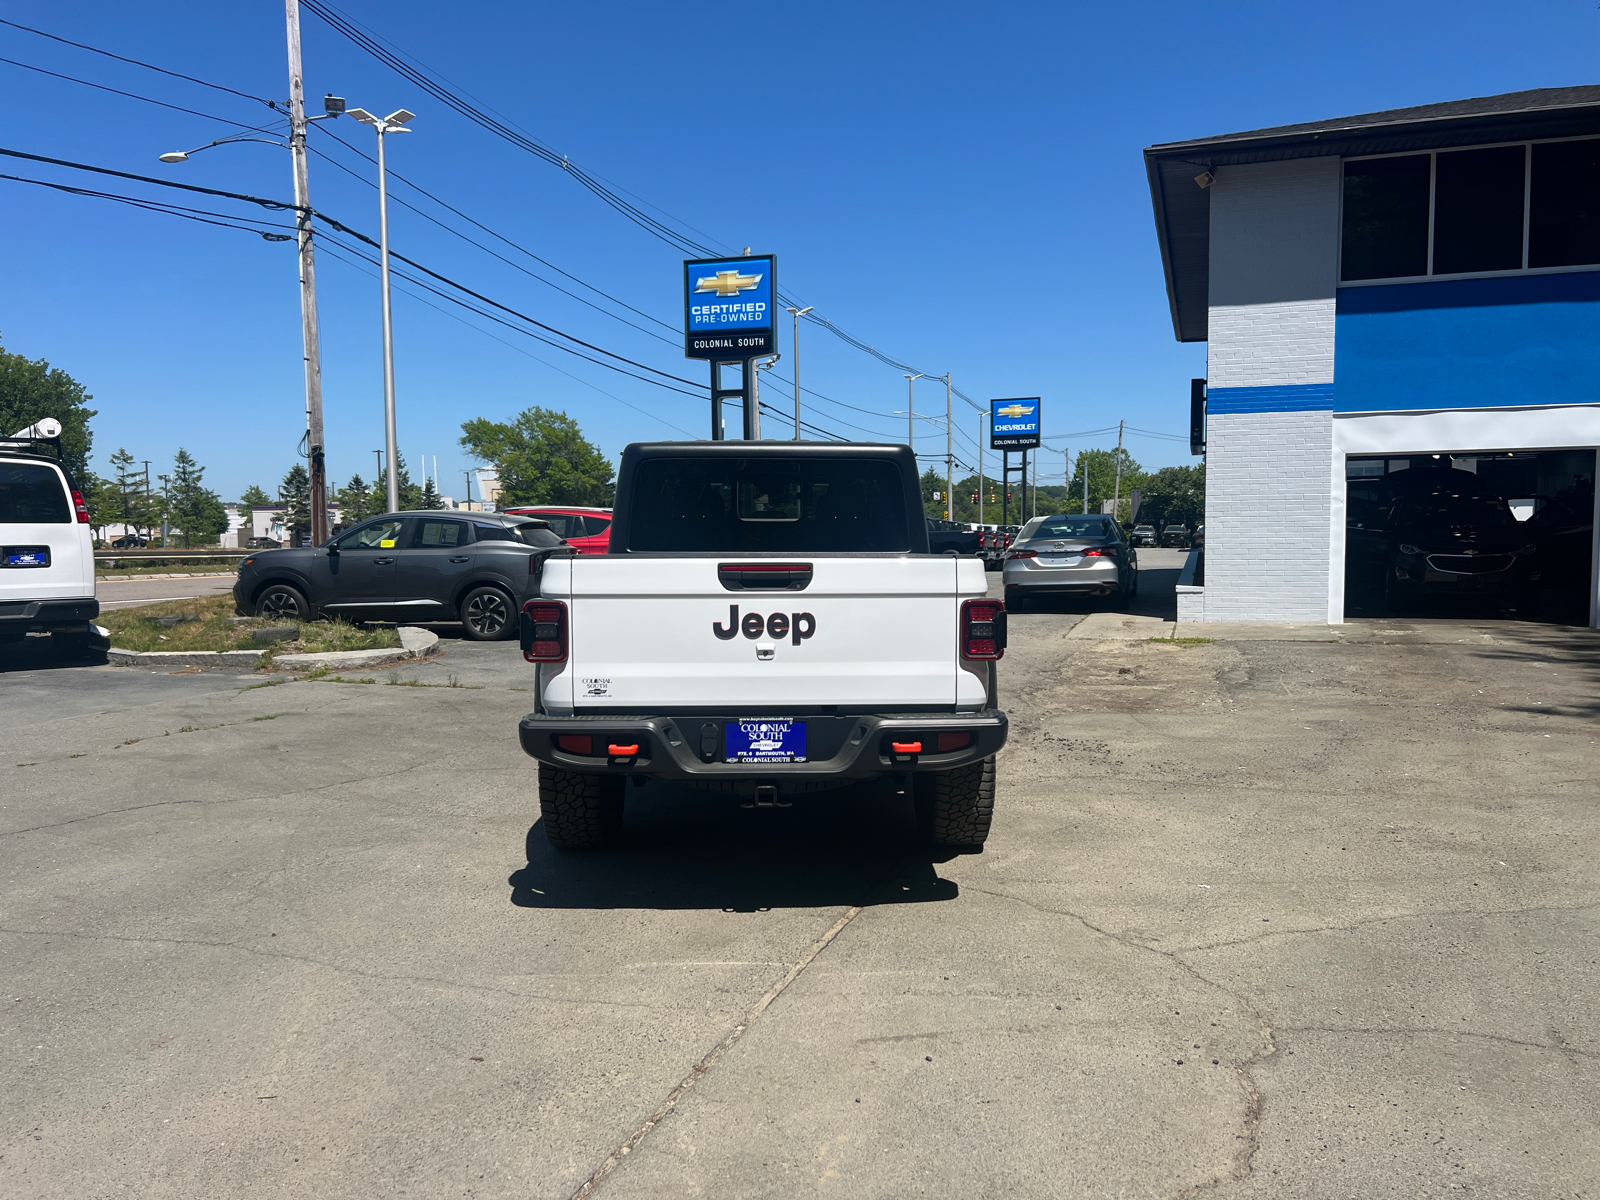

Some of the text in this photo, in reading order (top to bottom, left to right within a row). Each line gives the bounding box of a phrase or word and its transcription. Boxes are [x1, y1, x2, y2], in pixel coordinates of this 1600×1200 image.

[692, 302, 766, 314] CERTIFIED
[696, 312, 762, 324] PRE-OWNED
[694, 337, 764, 349] COLONIAL SOUTH
[995, 424, 1036, 432] CHEVROLET
[713, 604, 816, 646] Jeep
[741, 723, 791, 732] COLONIAL
[748, 732, 783, 740] SOUTH
